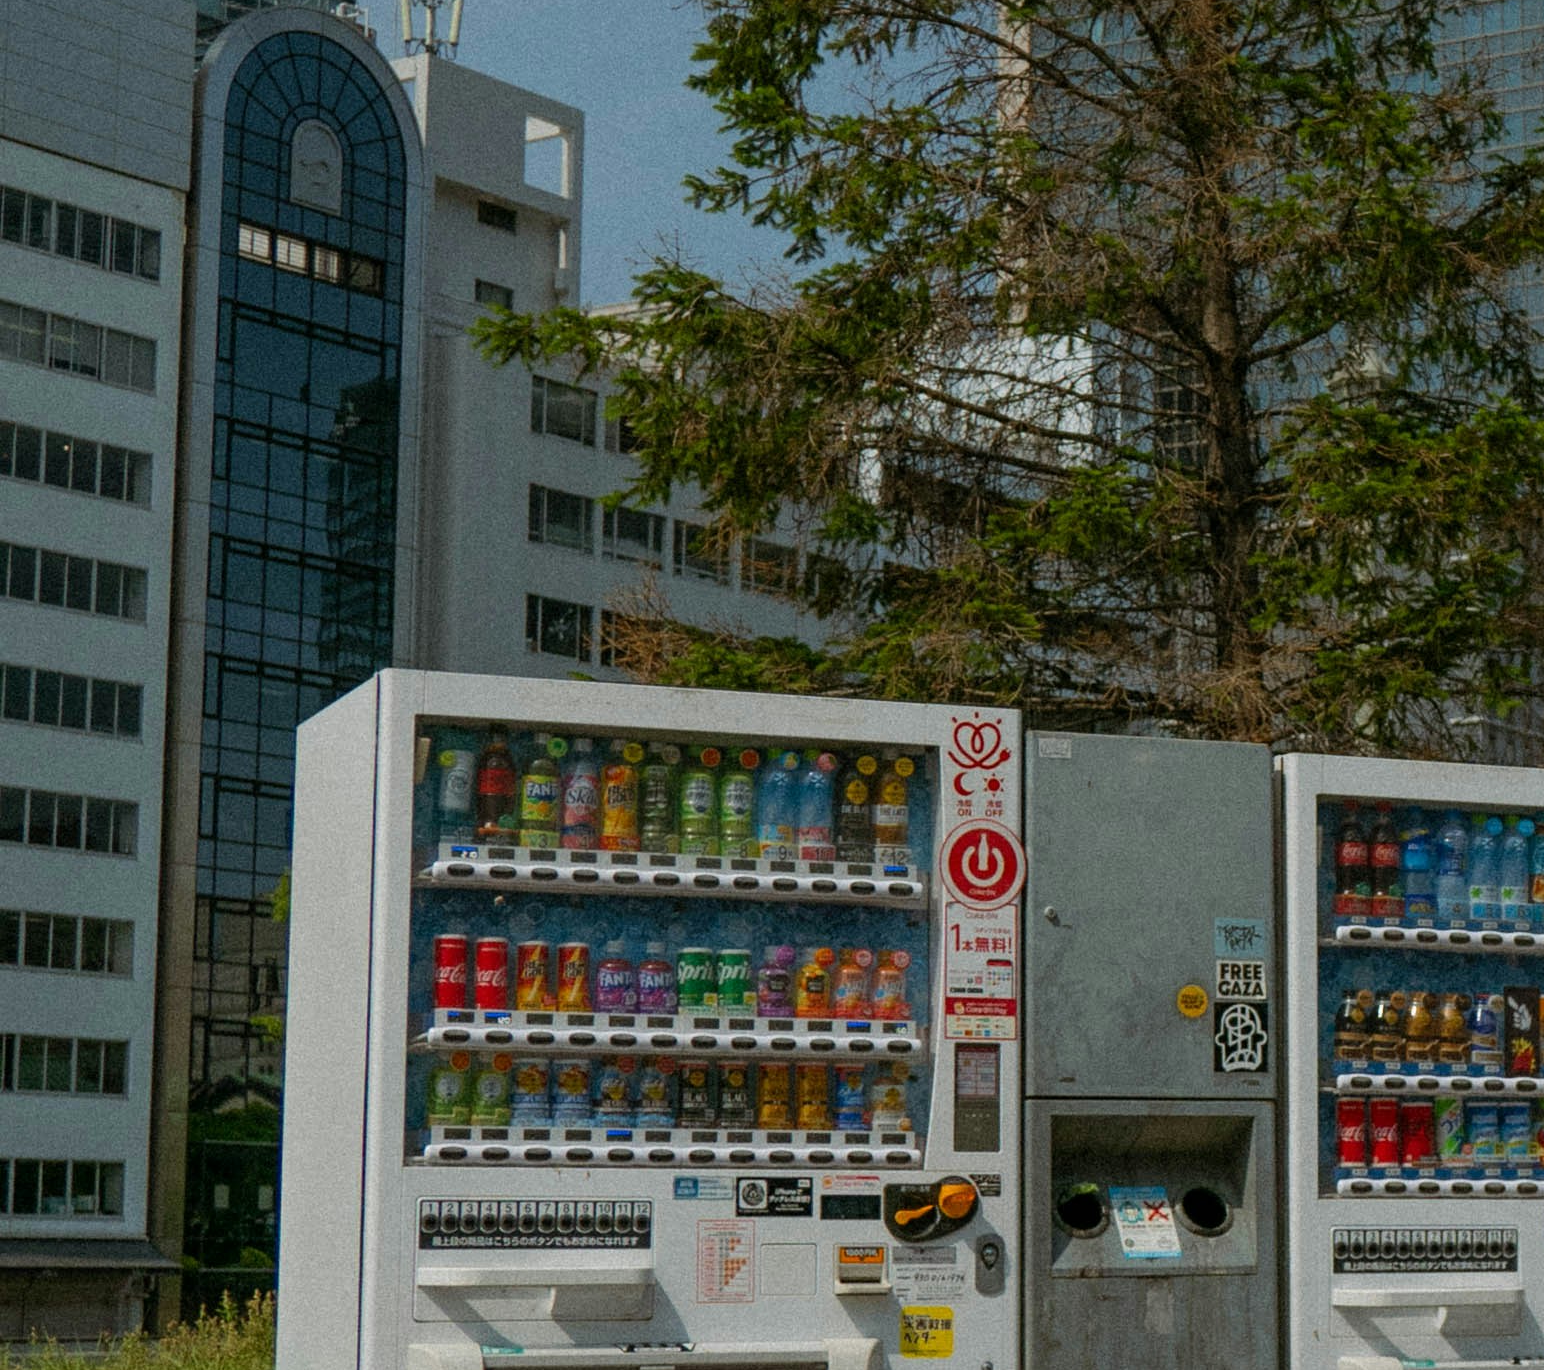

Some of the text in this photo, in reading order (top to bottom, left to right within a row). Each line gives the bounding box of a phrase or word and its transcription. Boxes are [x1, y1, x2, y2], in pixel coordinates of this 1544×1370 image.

[957, 809, 1004, 818] ON OFF
[1220, 963, 1262, 980] FREE
[1218, 981, 1264, 998] GAZA
[428, 1203, 648, 1213] 1 2 3 4 5 6 7 8 9 10 11 12
